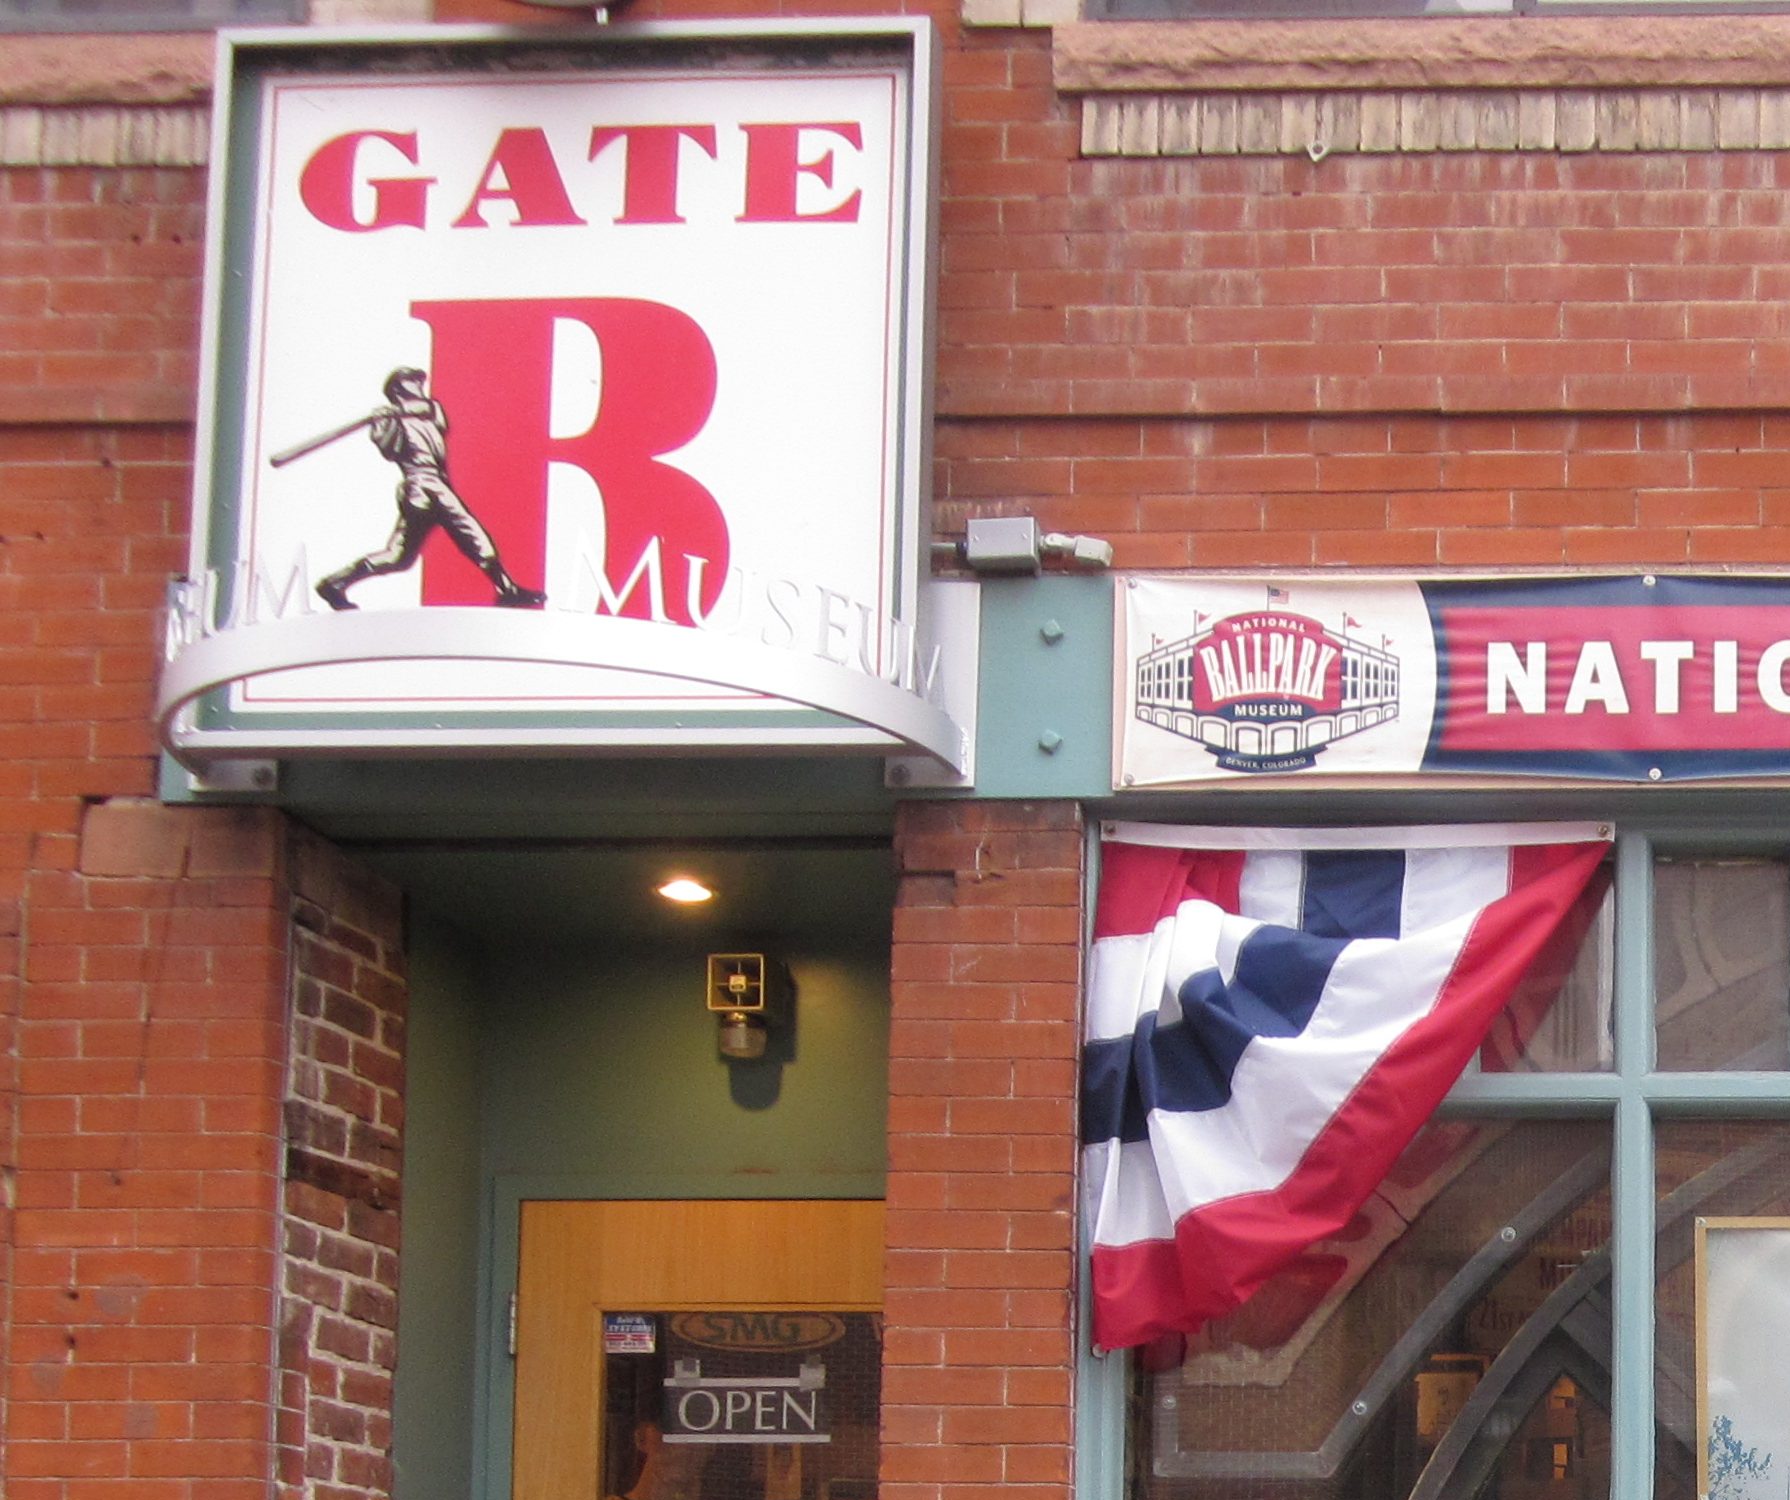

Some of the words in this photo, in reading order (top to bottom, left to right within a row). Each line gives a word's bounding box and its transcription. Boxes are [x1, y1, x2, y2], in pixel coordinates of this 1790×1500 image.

[296, 121, 865, 235] GATE
[1231, 617, 1306, 633] NATIONAL
[1199, 632, 1338, 703] BALLPARK
[1233, 703, 1304, 717] MUSEUM
[1261, 756, 1307, 770] COLORADO
[678, 1389, 816, 1432] OPEN
